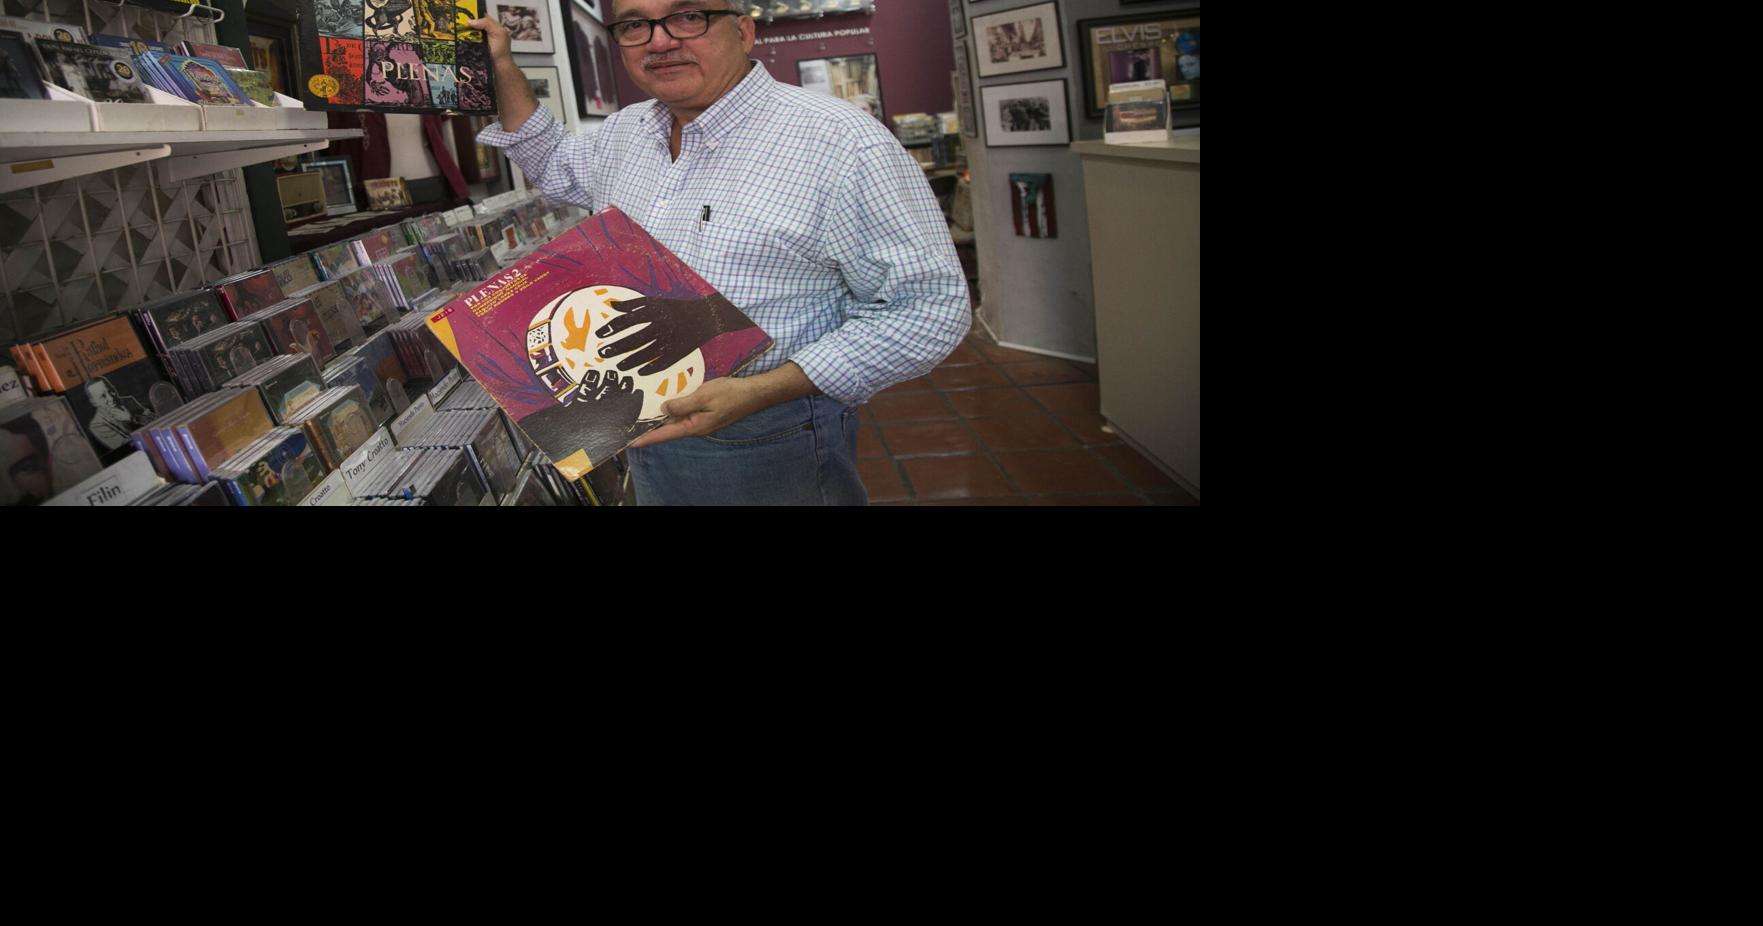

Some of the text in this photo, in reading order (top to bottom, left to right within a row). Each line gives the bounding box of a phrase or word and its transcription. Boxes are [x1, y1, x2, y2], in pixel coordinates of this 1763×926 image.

[764, 35, 786, 44] PARA
[786, 34, 797, 42] LA
[798, 30, 834, 41] CULTURA
[834, 27, 870, 37] POPULAR
[1095, 23, 1162, 45] ELVIS
[381, 61, 472, 84] PLENAS
[464, 273, 514, 307] PLENAS
[512, 268, 522, 278] 2
[0, 378, 20, 394] ez
[345, 437, 389, 480] Tony Croatto
[86, 485, 121, 506] Filin
